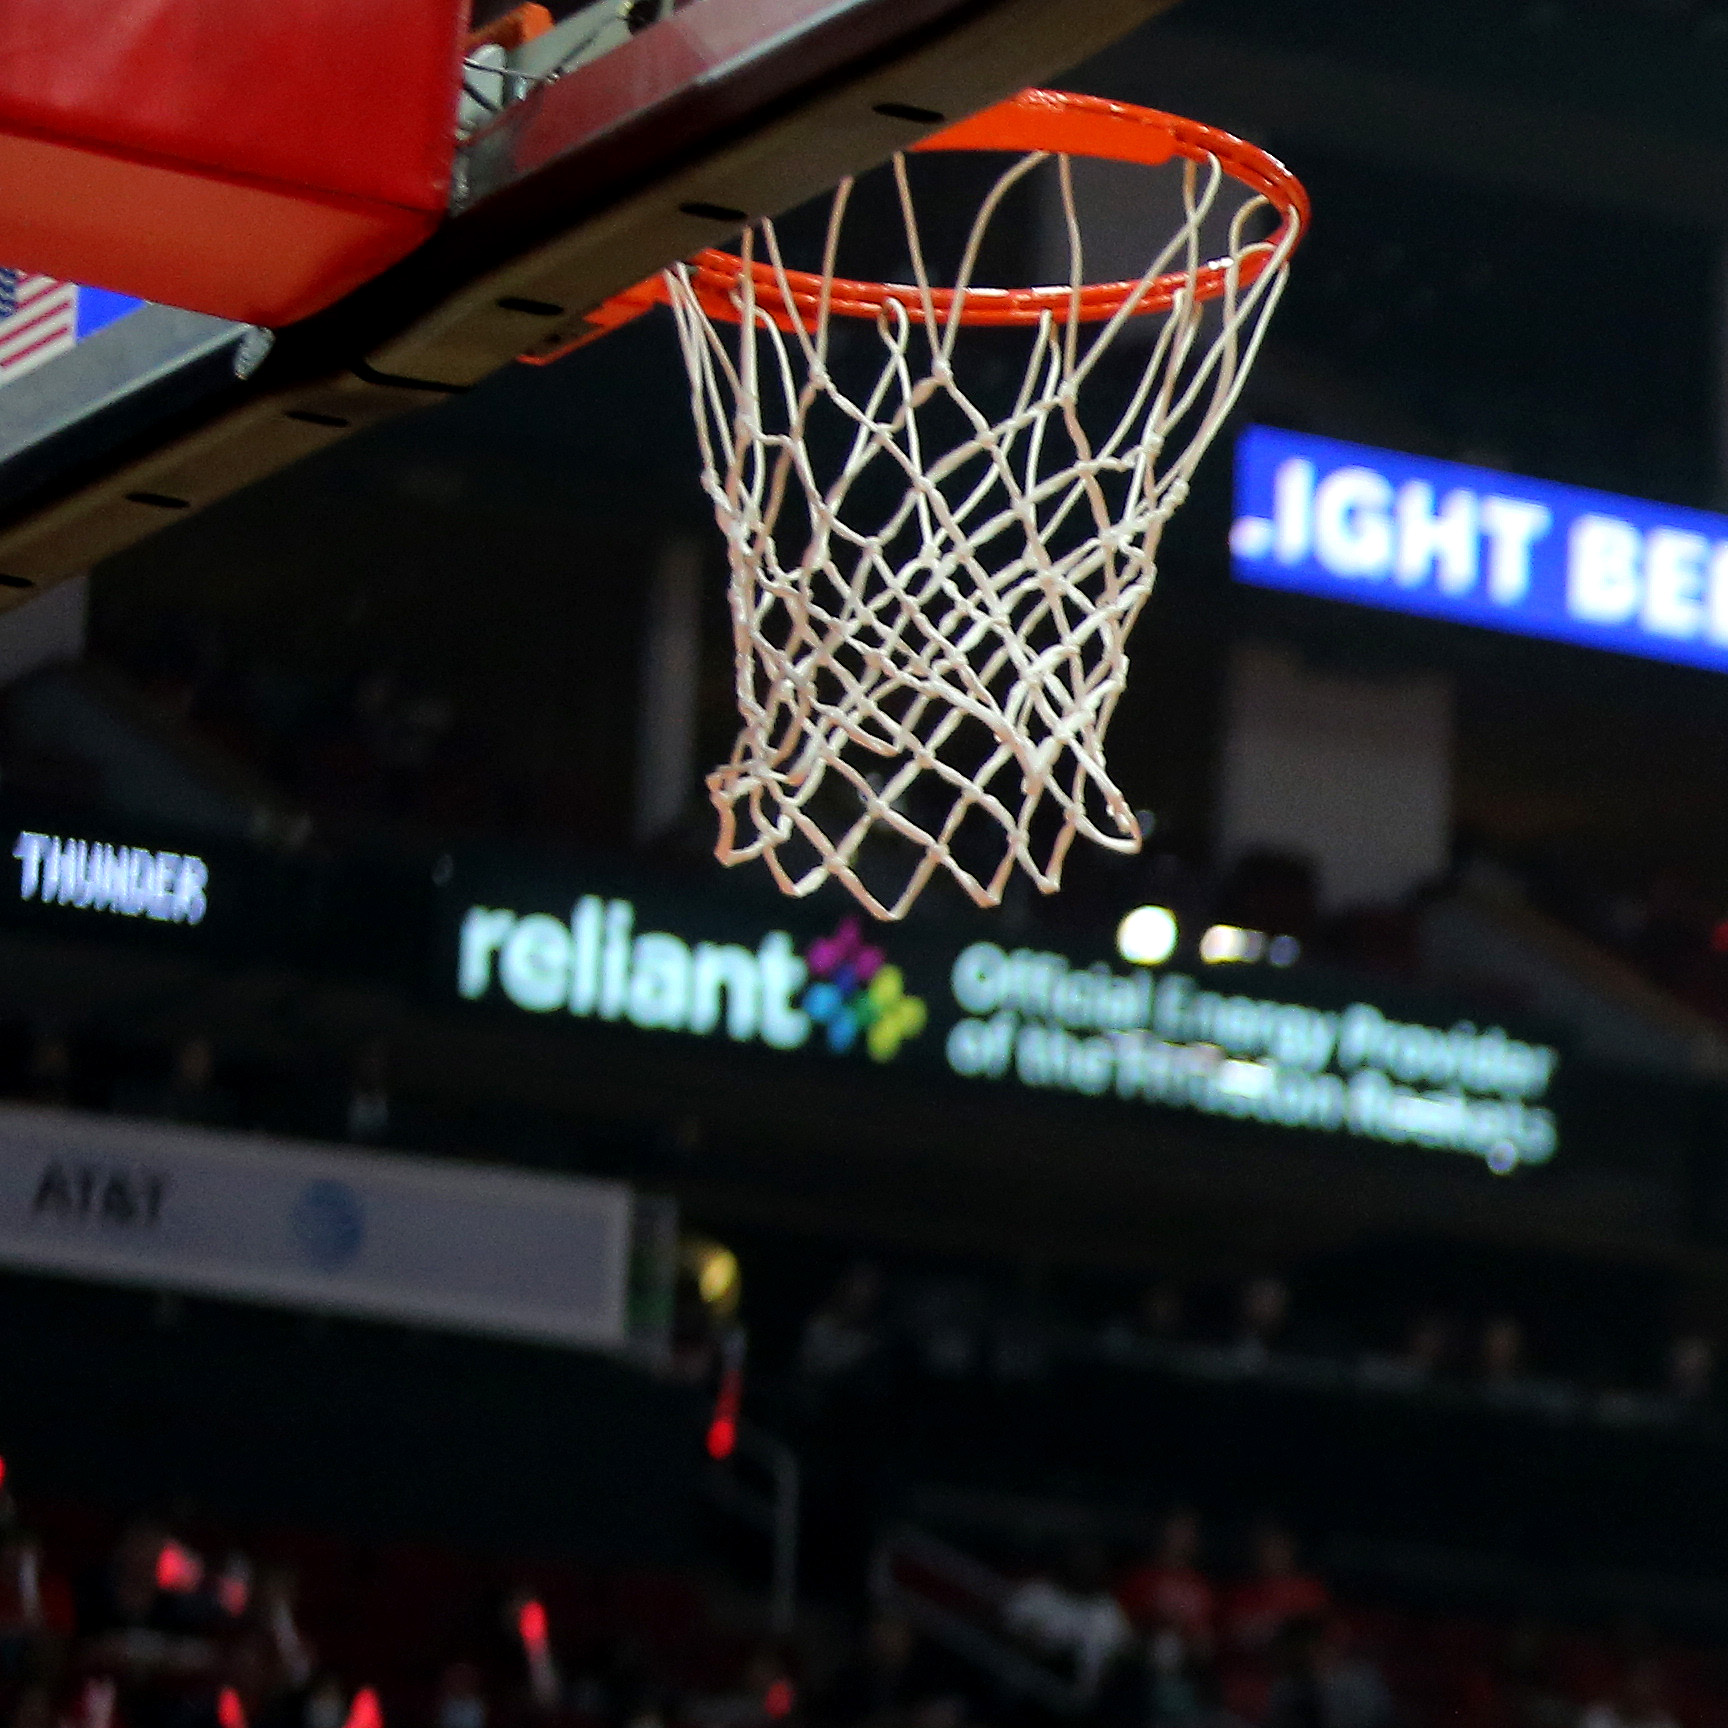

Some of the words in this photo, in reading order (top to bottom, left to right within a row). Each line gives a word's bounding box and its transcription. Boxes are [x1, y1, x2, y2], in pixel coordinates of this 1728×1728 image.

[1229, 456, 1553, 606] IGHT
[12, 830, 209, 926] THUNDER
[457, 894, 812, 1051] reliant
